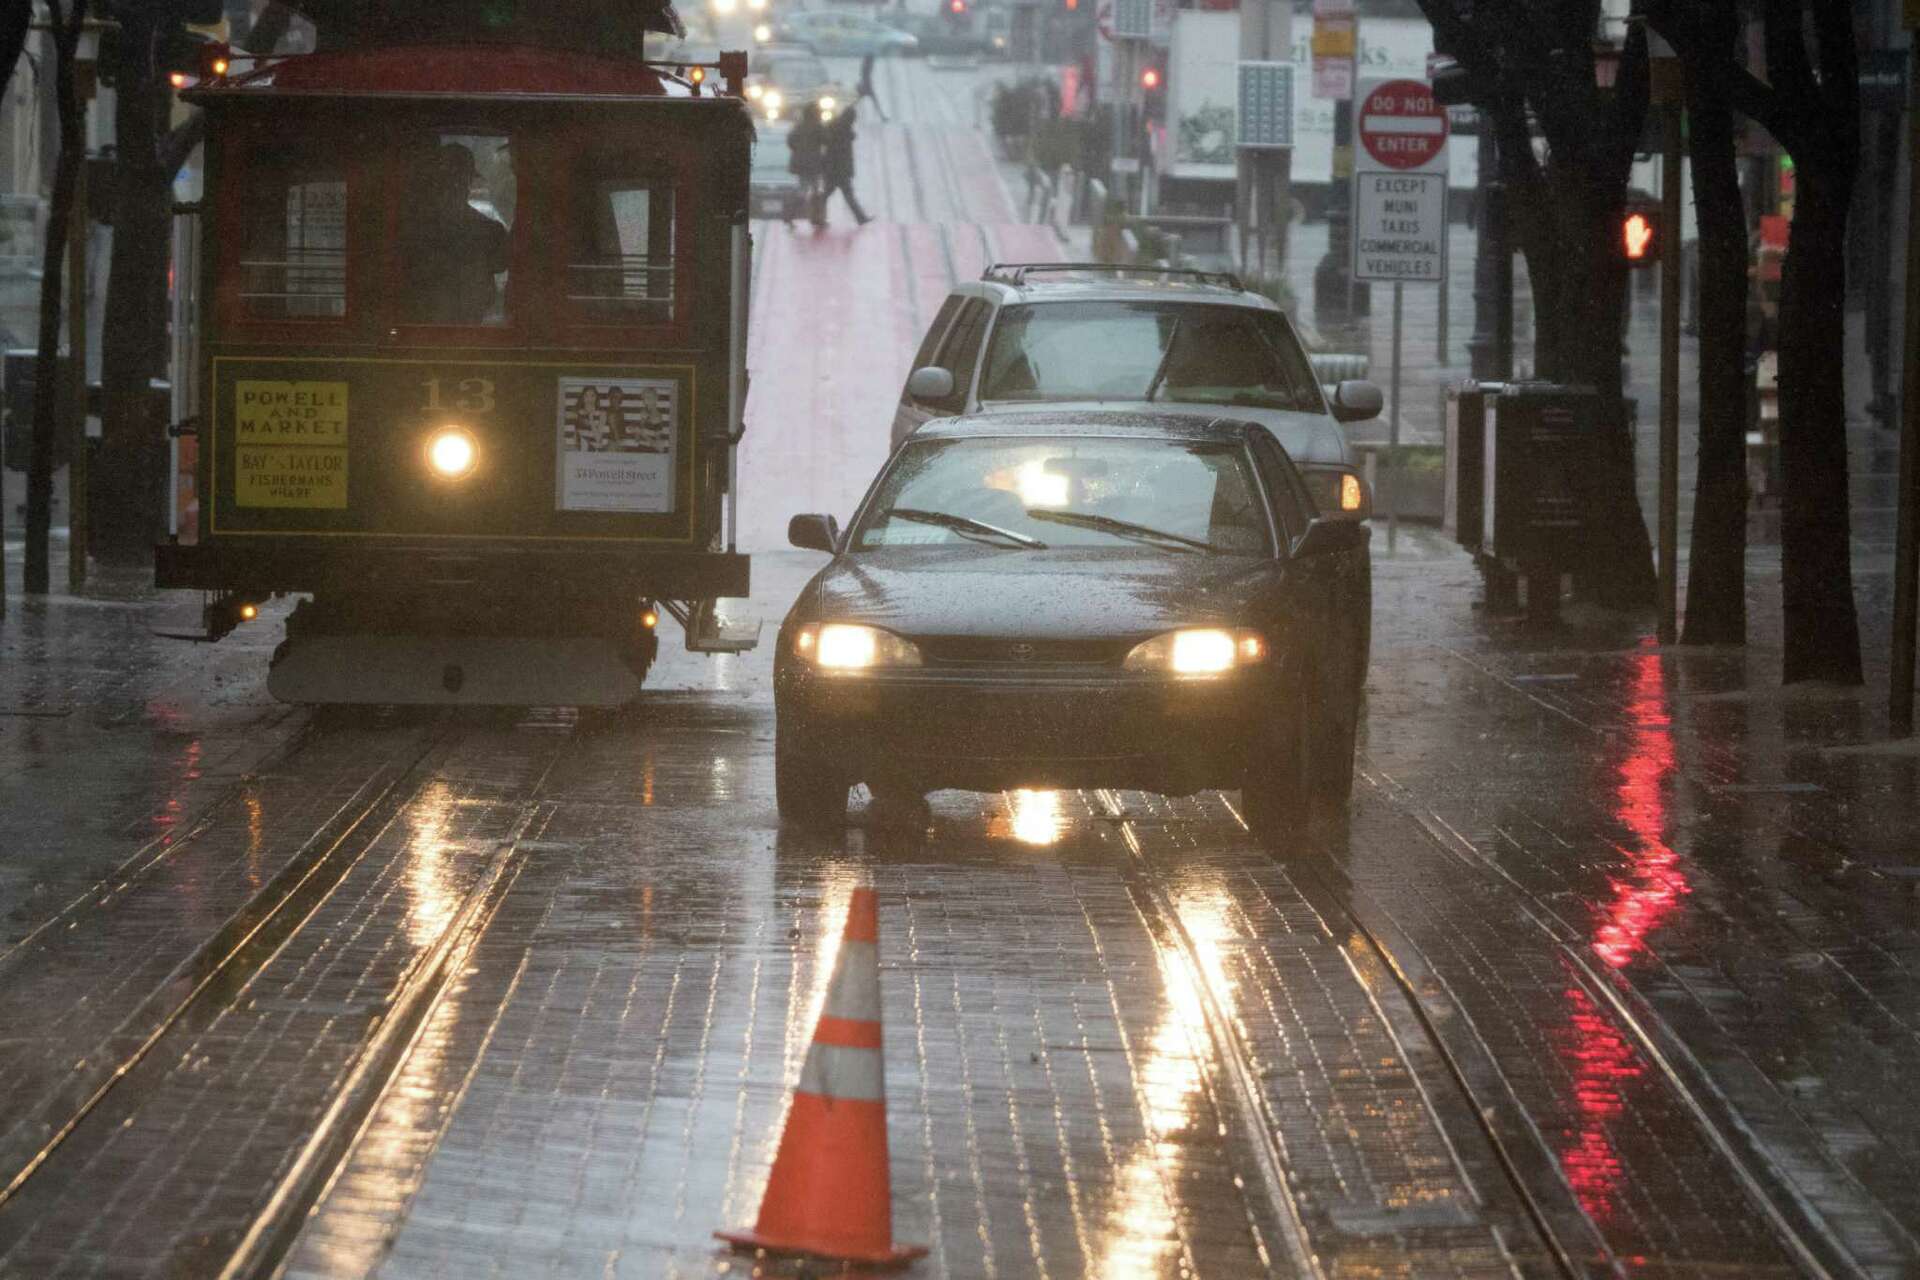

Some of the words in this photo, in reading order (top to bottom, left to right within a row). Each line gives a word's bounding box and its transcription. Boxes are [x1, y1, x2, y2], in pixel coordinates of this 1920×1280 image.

[1372, 96, 1395, 111] DO
[1404, 97, 1435, 113] NOT
[1377, 137, 1428, 152] ENTER
[1375, 178, 1427, 193] EXCEPT
[1383, 199, 1418, 213] MUNI
[1381, 219, 1421, 234] TAXIS
[1360, 239, 1439, 254] COMMERCIAL
[1366, 259, 1433, 275] VEHICLES
[243, 391, 343, 406] POWELL
[419, 378, 496, 413] 13
[269, 407, 318, 419] AND
[240, 420, 344, 434] MARKET
[241, 454, 266, 470] BAY
[289, 455, 343, 471] TAYLOR
[270, 487, 313, 498] WHARF
